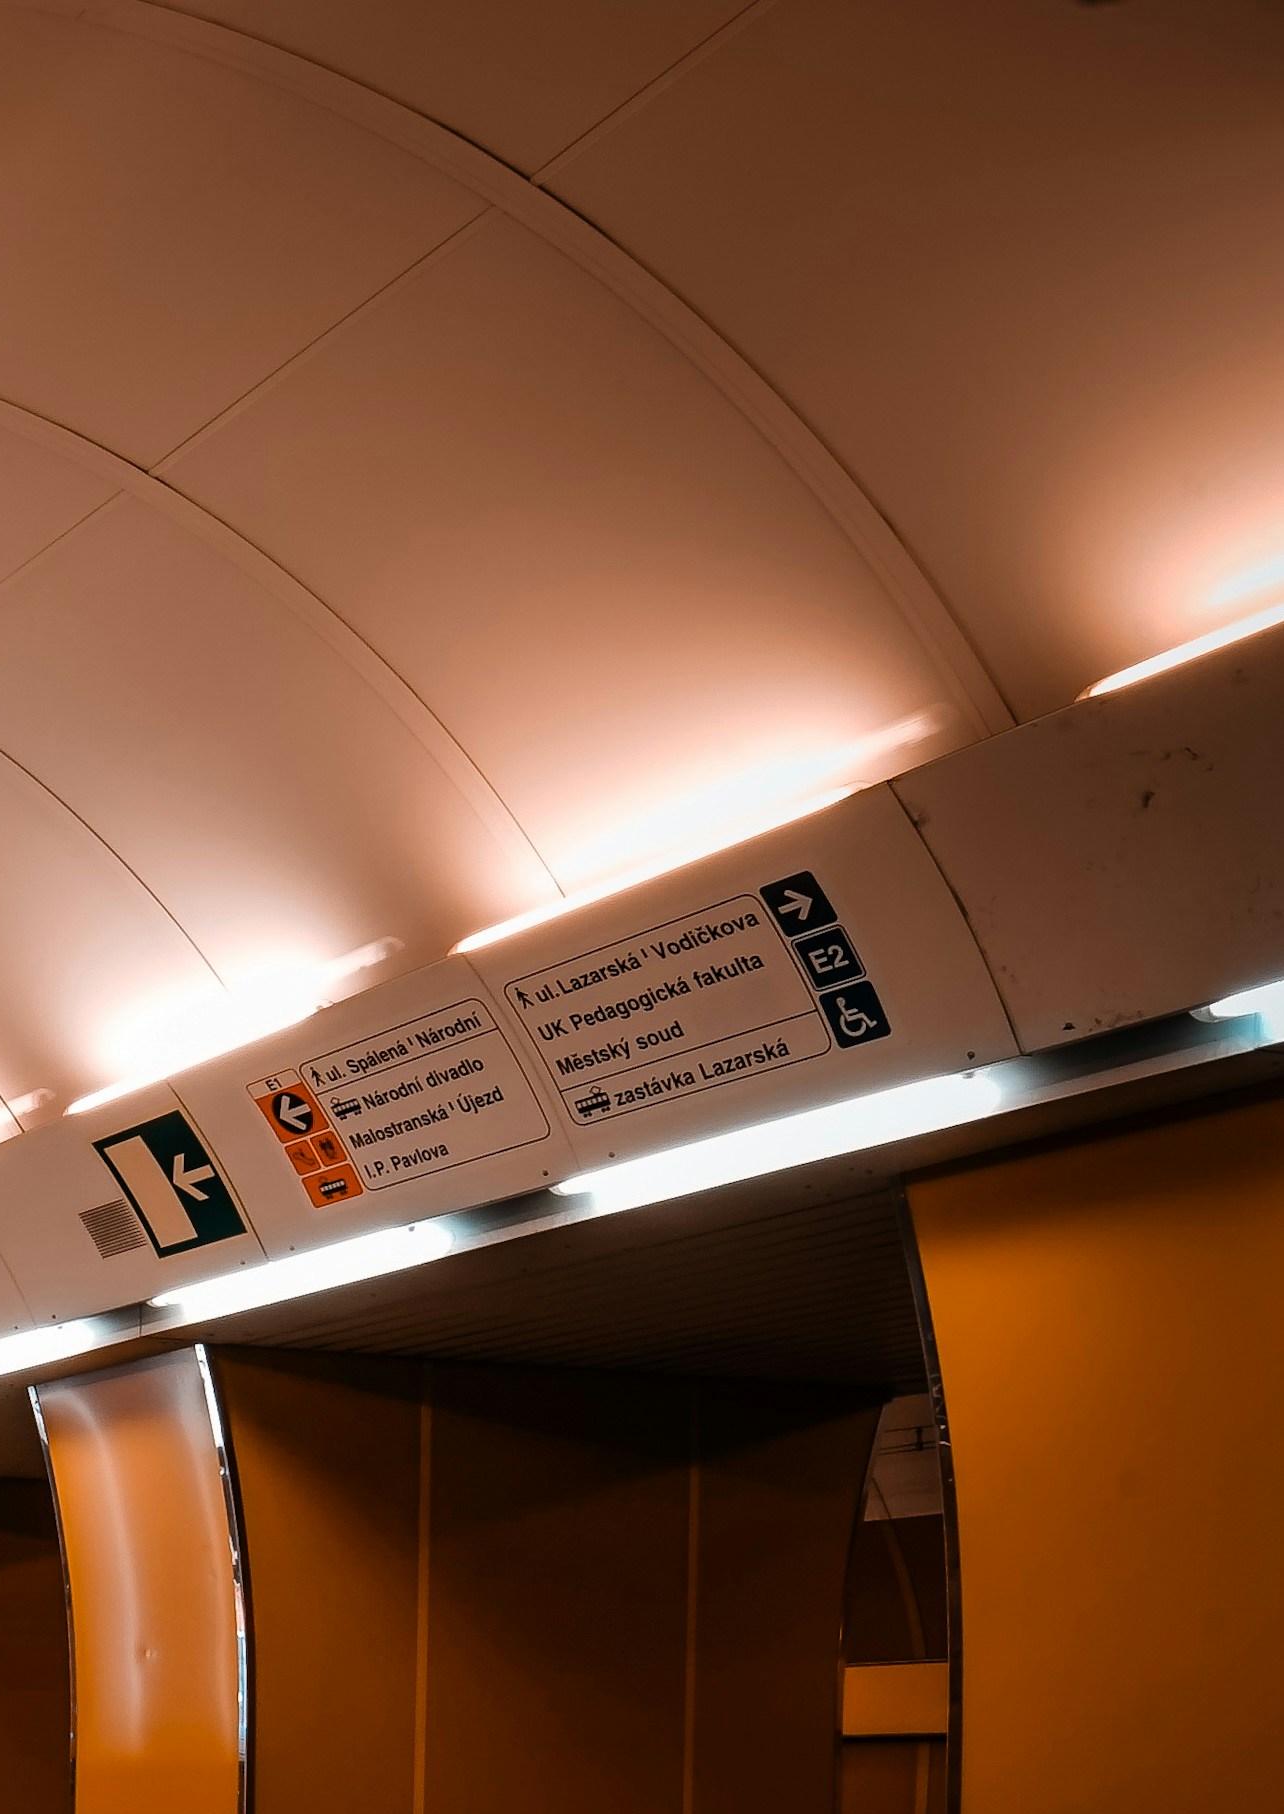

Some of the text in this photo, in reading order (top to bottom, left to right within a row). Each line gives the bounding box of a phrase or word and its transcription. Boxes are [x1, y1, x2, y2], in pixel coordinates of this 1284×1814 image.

[535, 914, 760, 1002] ul. Lazarská Vodičkova
[807, 945, 849, 974] E2
[537, 955, 765, 1040] UK Pedagogická fakulta
[325, 1010, 482, 1082] ul. Spálená Národní
[556, 1020, 684, 1076] Městský soud
[613, 1038, 790, 1107] zastávka Lazarská
[265, 1078, 282, 1091] E1
[361, 1057, 484, 1110] Národní divadlo
[349, 1085, 504, 1150] Malostranská Újezd
[364, 1143, 449, 1179] I.P. Pavlova
